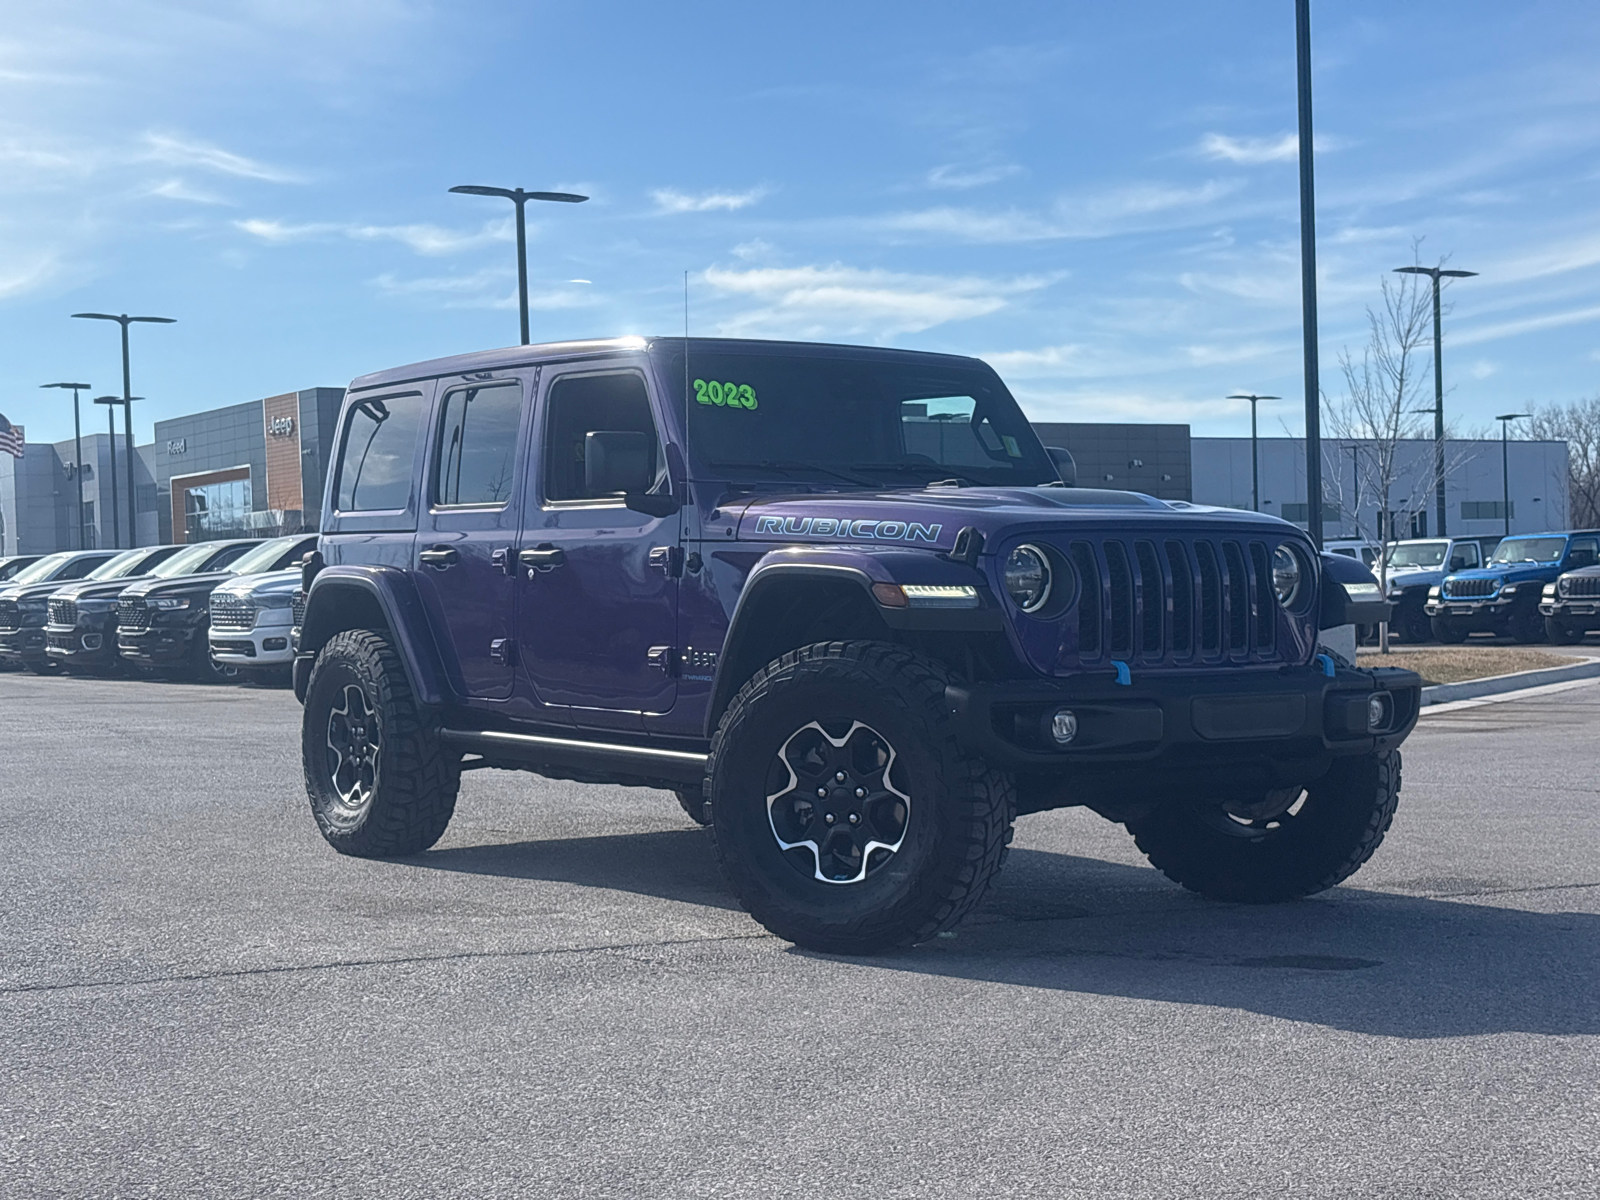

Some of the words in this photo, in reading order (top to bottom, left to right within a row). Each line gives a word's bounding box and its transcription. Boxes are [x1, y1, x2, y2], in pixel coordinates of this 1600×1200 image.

[693, 379, 758, 410] 2023
[268, 416, 295, 437] Jeep
[167, 438, 187, 455] Reed
[755, 515, 943, 543] RUBICON
